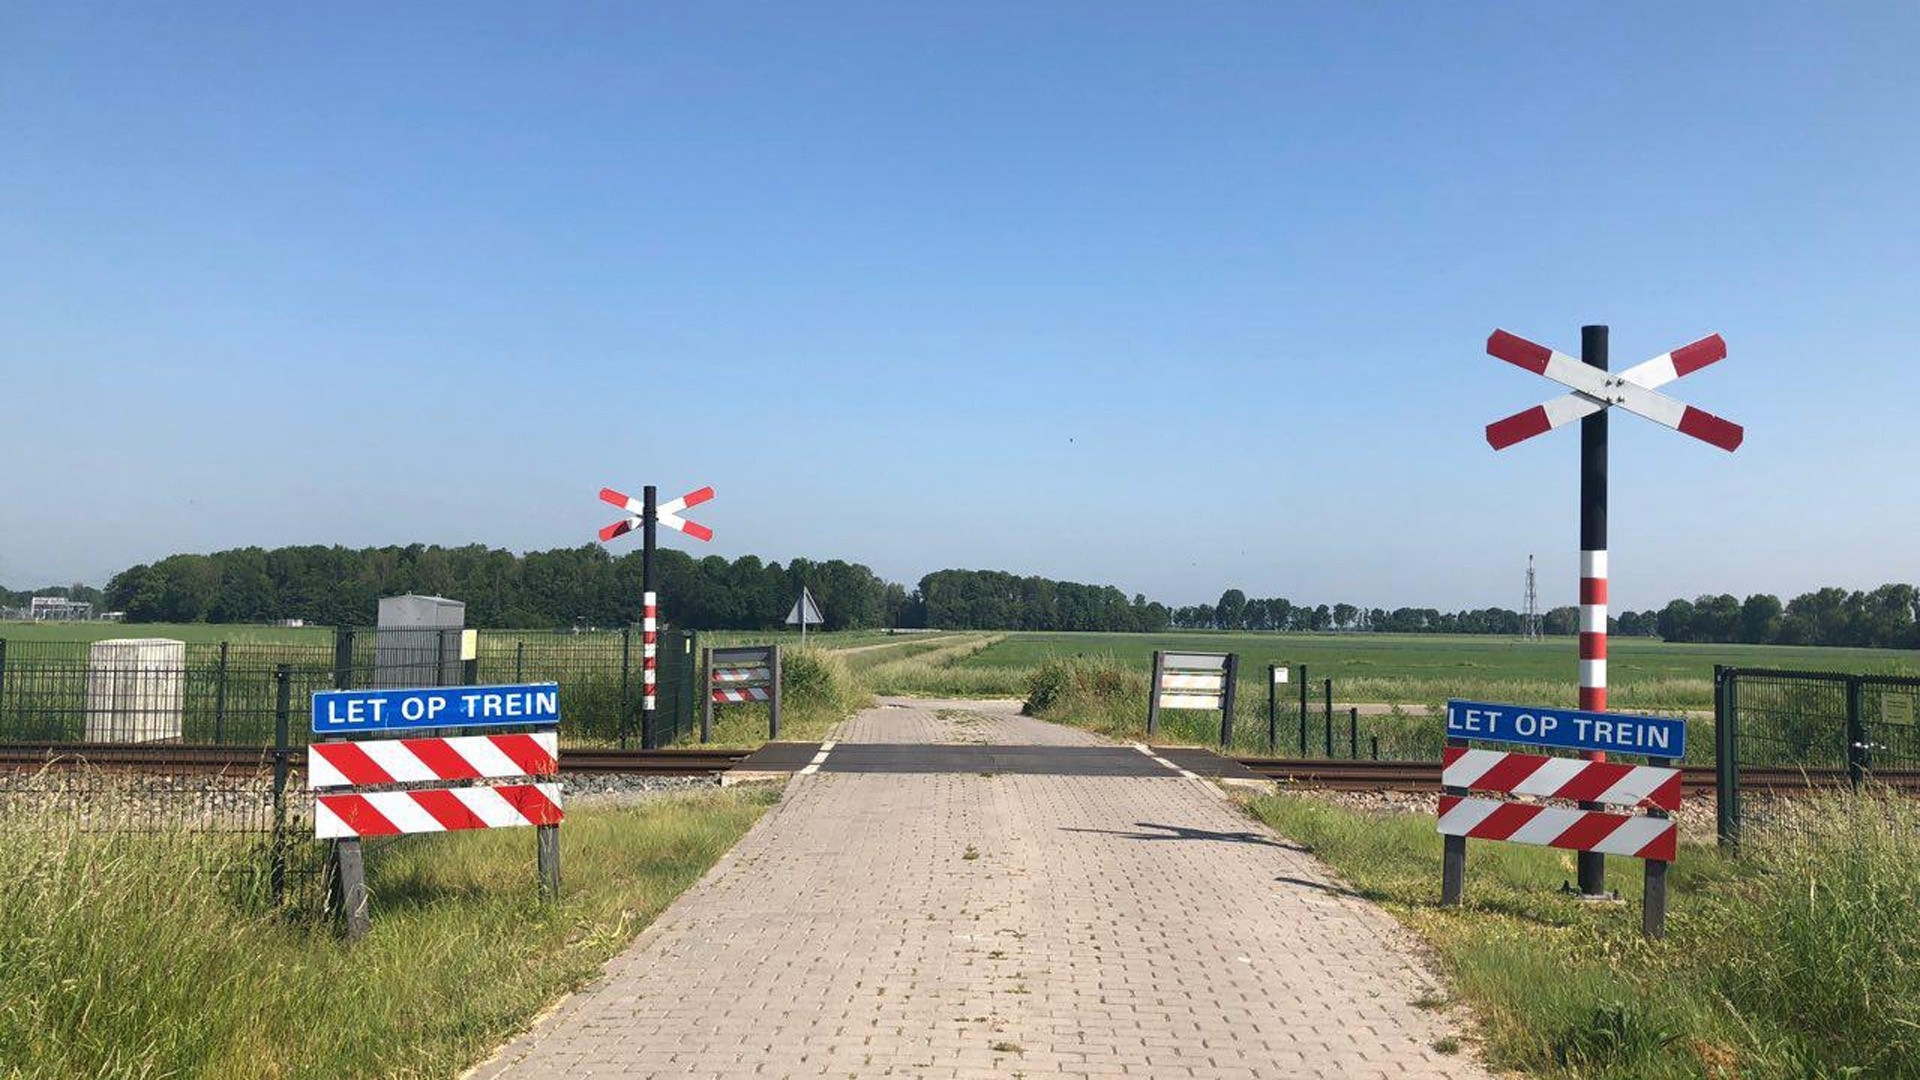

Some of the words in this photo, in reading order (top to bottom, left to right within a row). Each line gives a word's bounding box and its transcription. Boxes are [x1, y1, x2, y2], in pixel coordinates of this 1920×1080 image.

[328, 699, 388, 724] LET
[401, 696, 446, 721] OP
[461, 692, 556, 718] TREIN
[1447, 707, 1502, 733] LET
[1515, 714, 1558, 737] OP
[1573, 719, 1670, 749] TREIN
